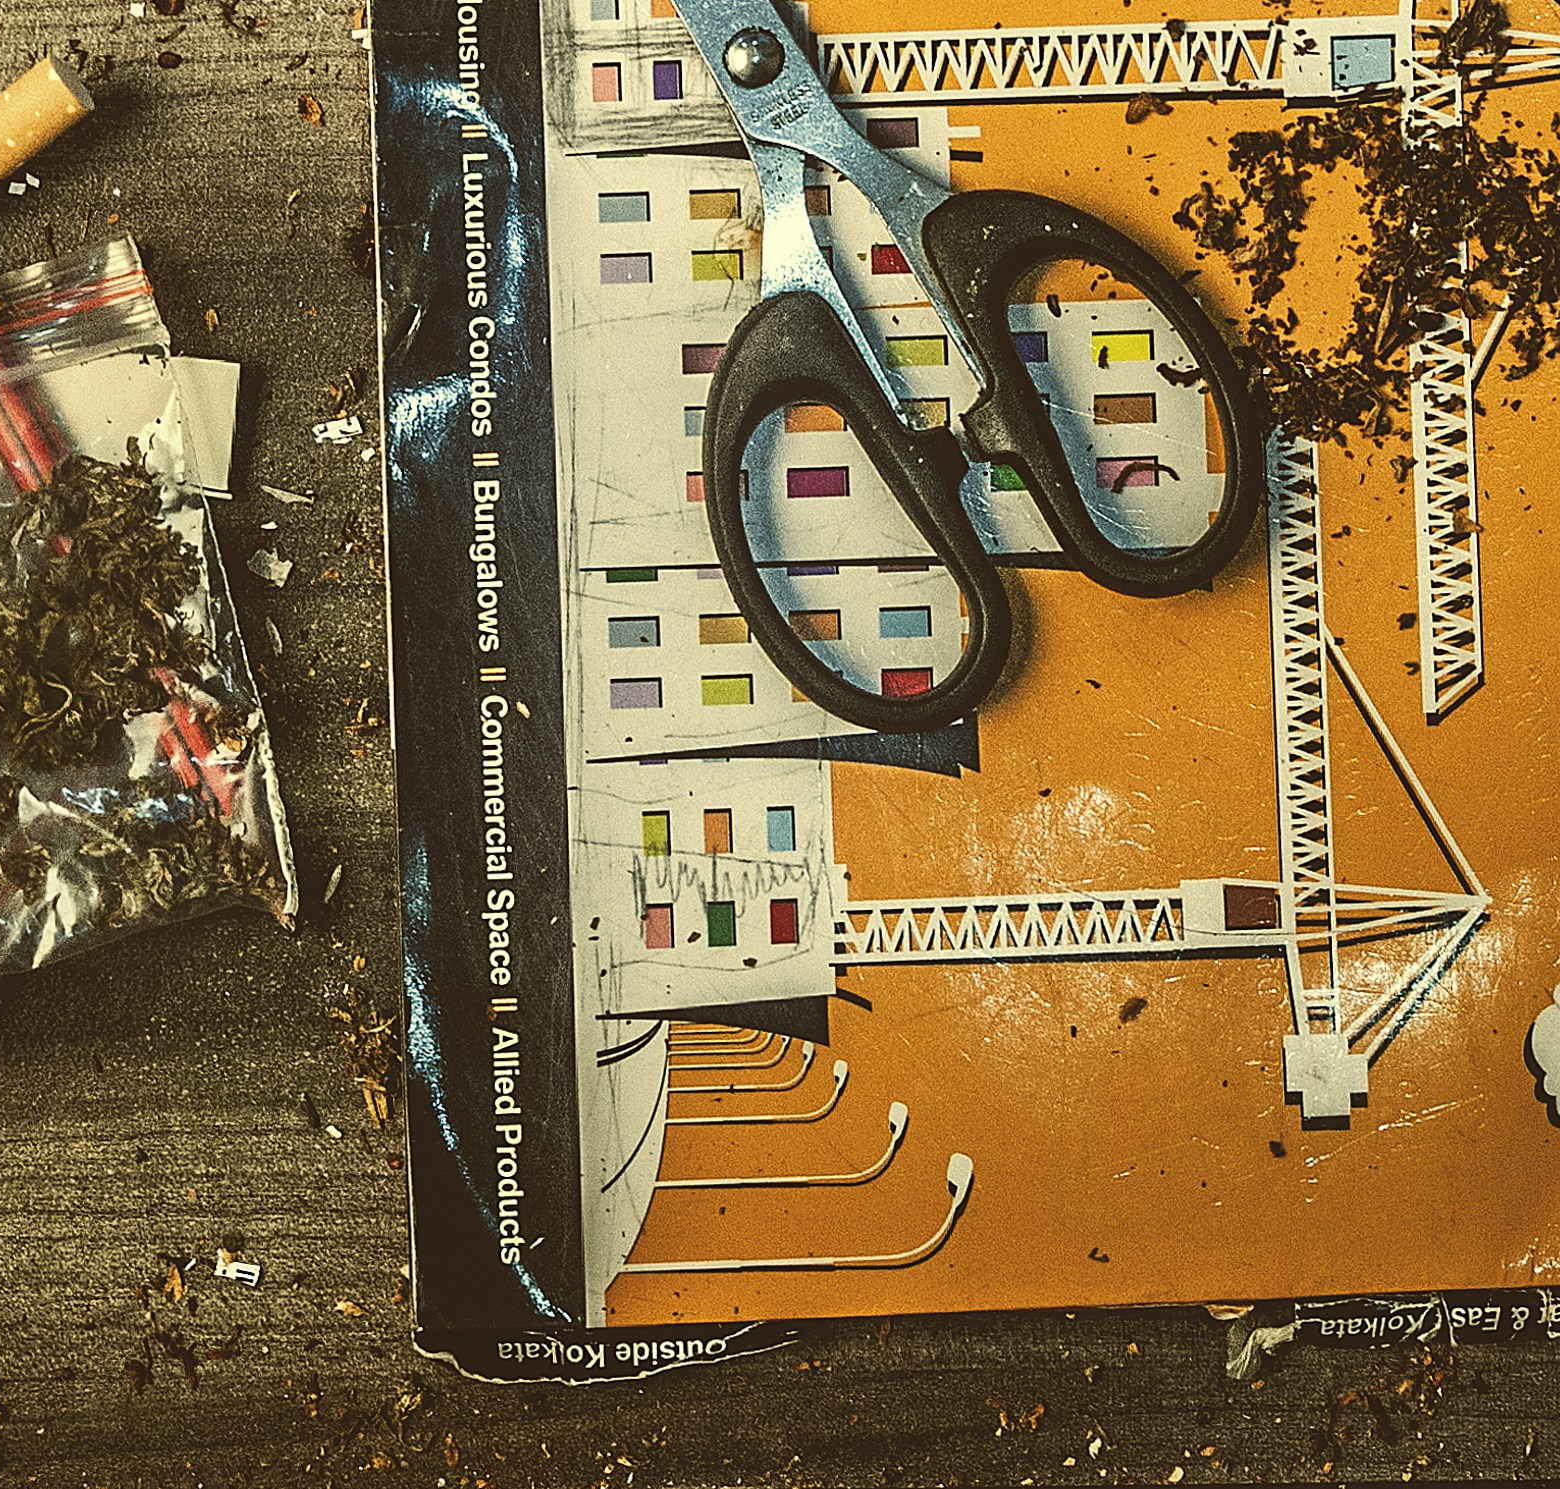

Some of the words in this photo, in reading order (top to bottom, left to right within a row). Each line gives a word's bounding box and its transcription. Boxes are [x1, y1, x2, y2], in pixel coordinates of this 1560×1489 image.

[462, 152, 490, 309] Luxurious
[468, 317, 493, 436] Condos
[472, 479, 504, 651] Bungalows
[479, 694, 513, 881] Commercial
[485, 889, 513, 986] Space
[492, 1028, 523, 1115] Allied
[496, 1123, 526, 1266] Products
[497, 1342, 606, 1369] Kolkata
[1321, 1310, 1428, 1341] Kolkata
